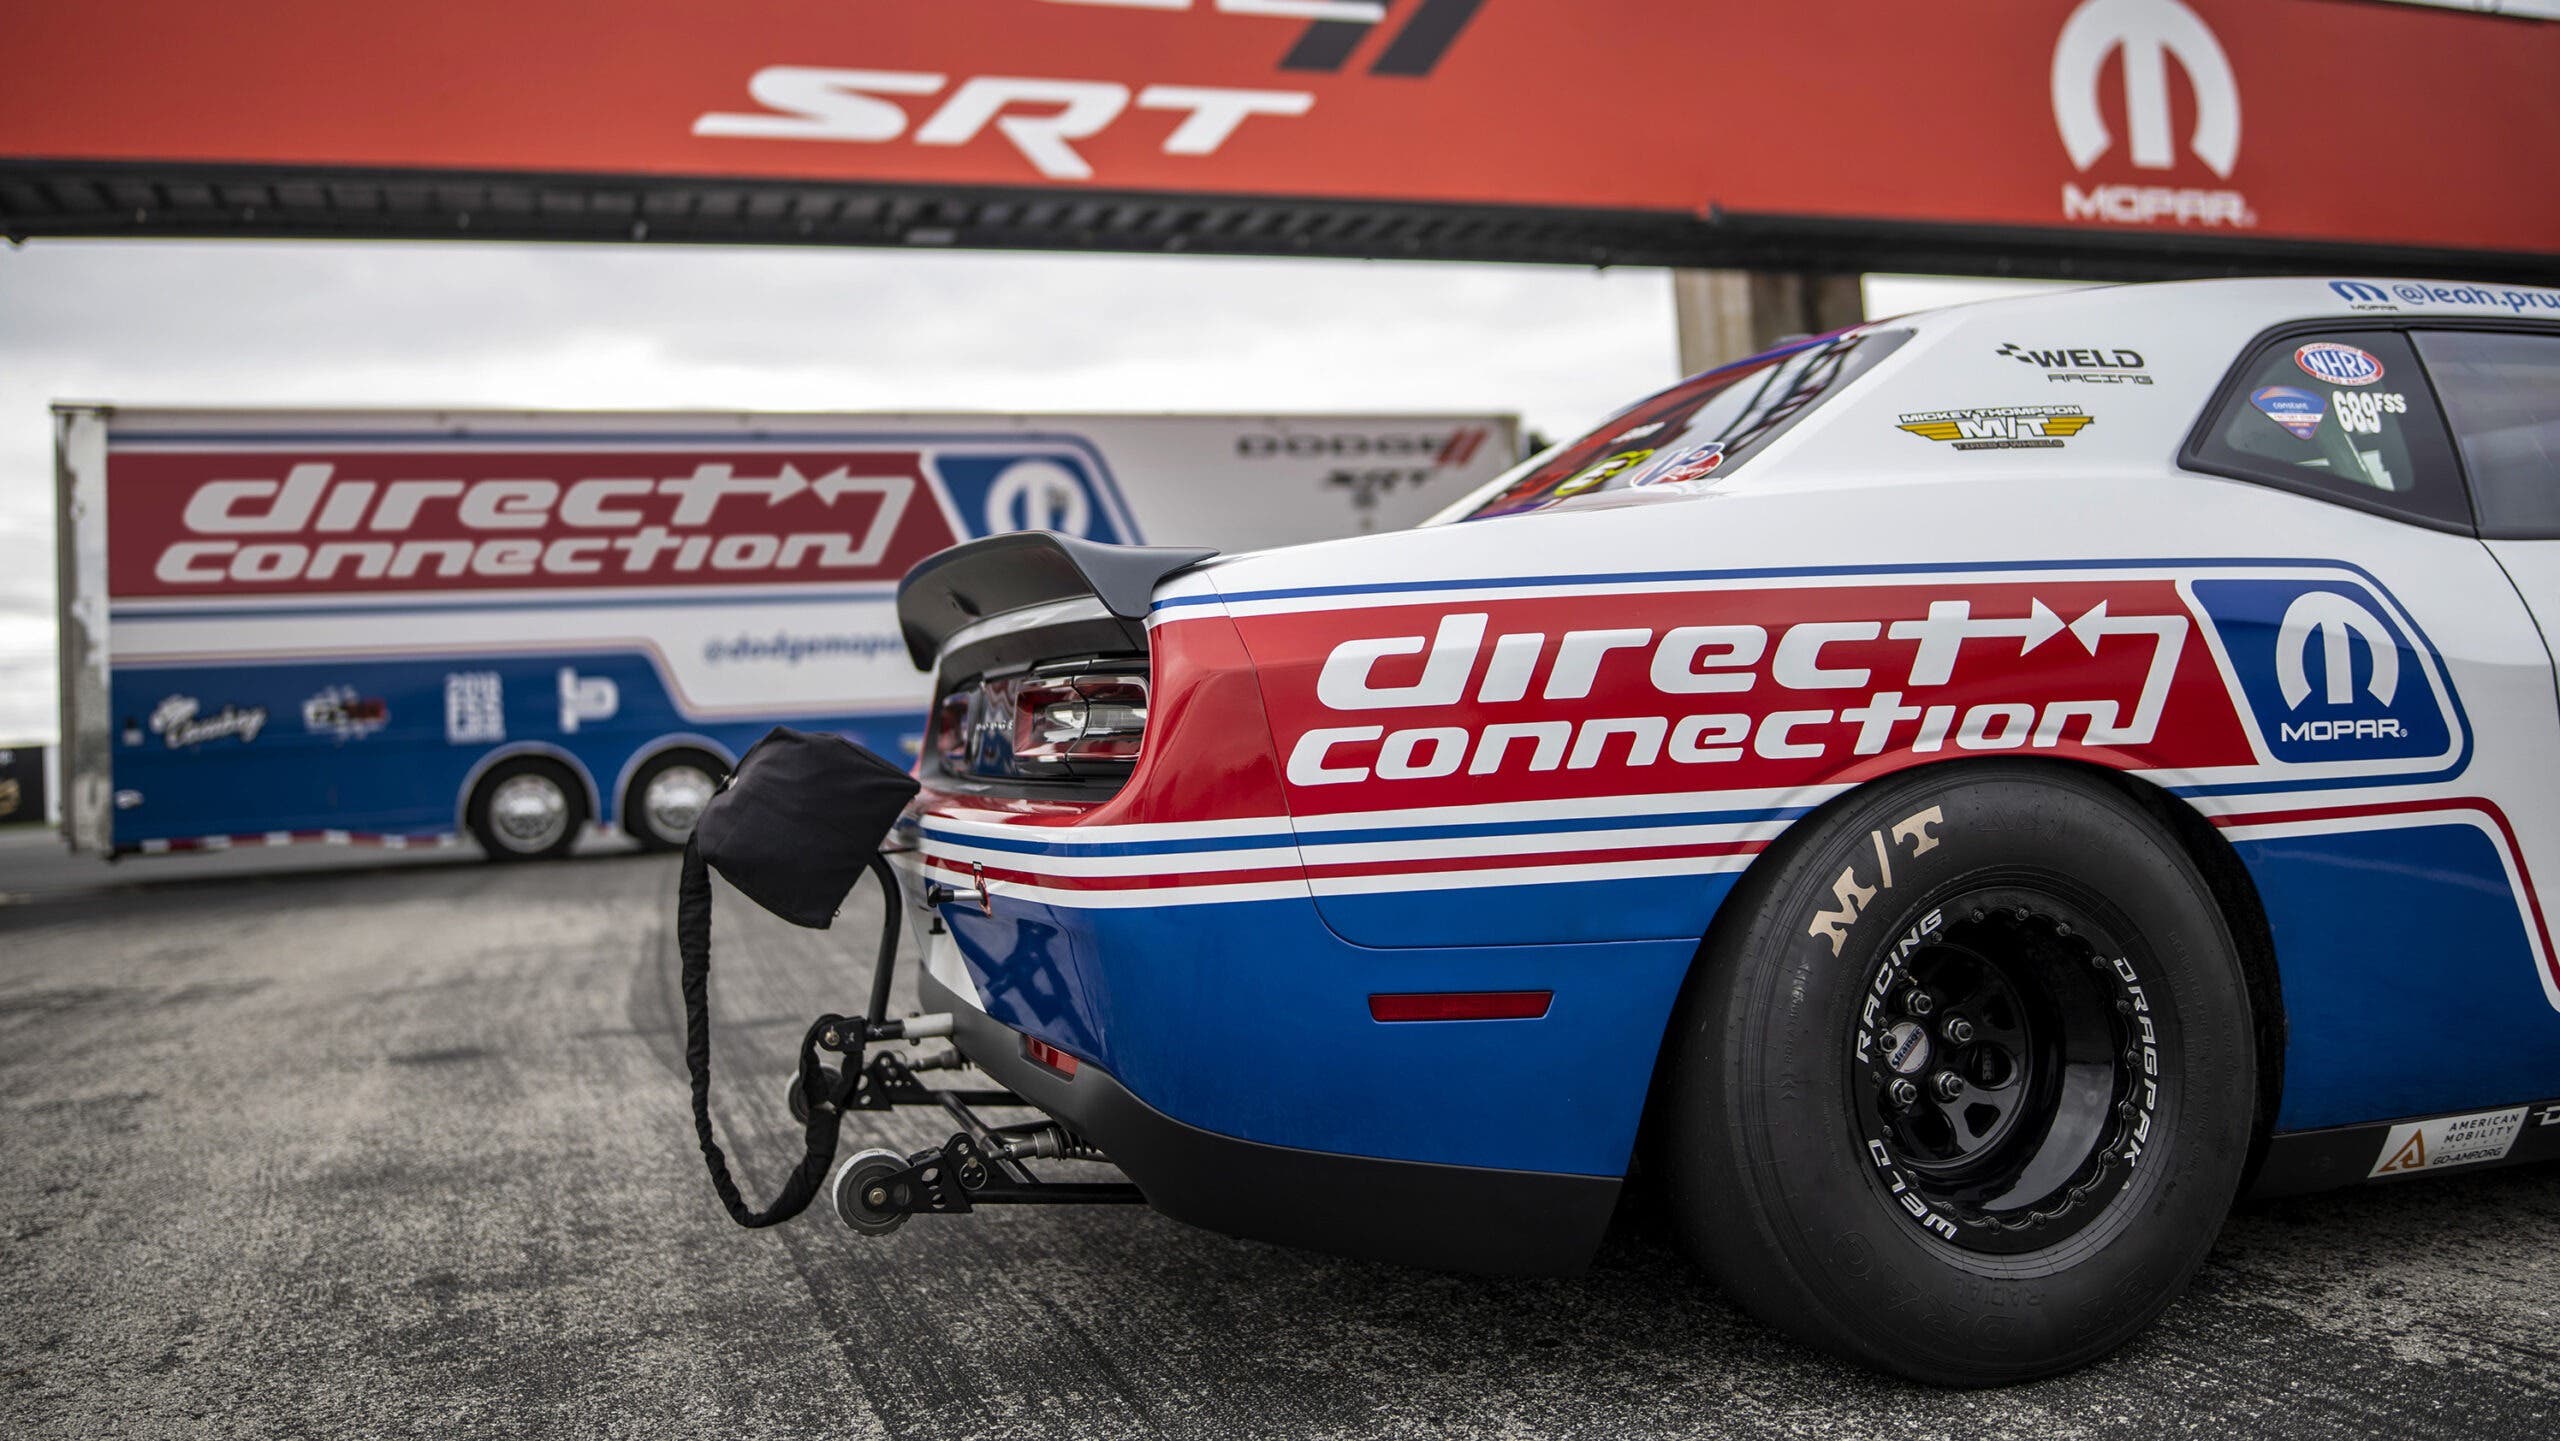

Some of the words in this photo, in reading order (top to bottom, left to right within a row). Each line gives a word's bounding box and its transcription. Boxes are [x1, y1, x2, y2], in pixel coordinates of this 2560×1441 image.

[691, 66, 1315, 179] SRT
[2062, 183, 2247, 227] MOPAR
[2028, 349, 2145, 368] WELD
[2047, 374, 2154, 385] RACING
[2305, 350, 2374, 378] NHRA
[1900, 409, 1971, 424] MICKEY
[1975, 405, 2082, 418] THOMPSON
[2332, 390, 2382, 434] 689
[2372, 393, 2407, 413] FSS
[183, 463, 736, 533] direct
[155, 528, 854, 583] connection
[1316, 601, 1972, 711] direct
[1286, 691, 2120, 786] connection
[2280, 719, 2401, 742] MOPAR
[1808, 805, 1944, 958] M/T
[1855, 908, 1944, 1064] RACING
[2113, 957, 2158, 1168] DRAGPAK
[2443, 1125, 2514, 1143] MOBILITY
[2449, 1113, 2520, 1132] AMERICAN
[1868, 1139, 1959, 1240] WELD
